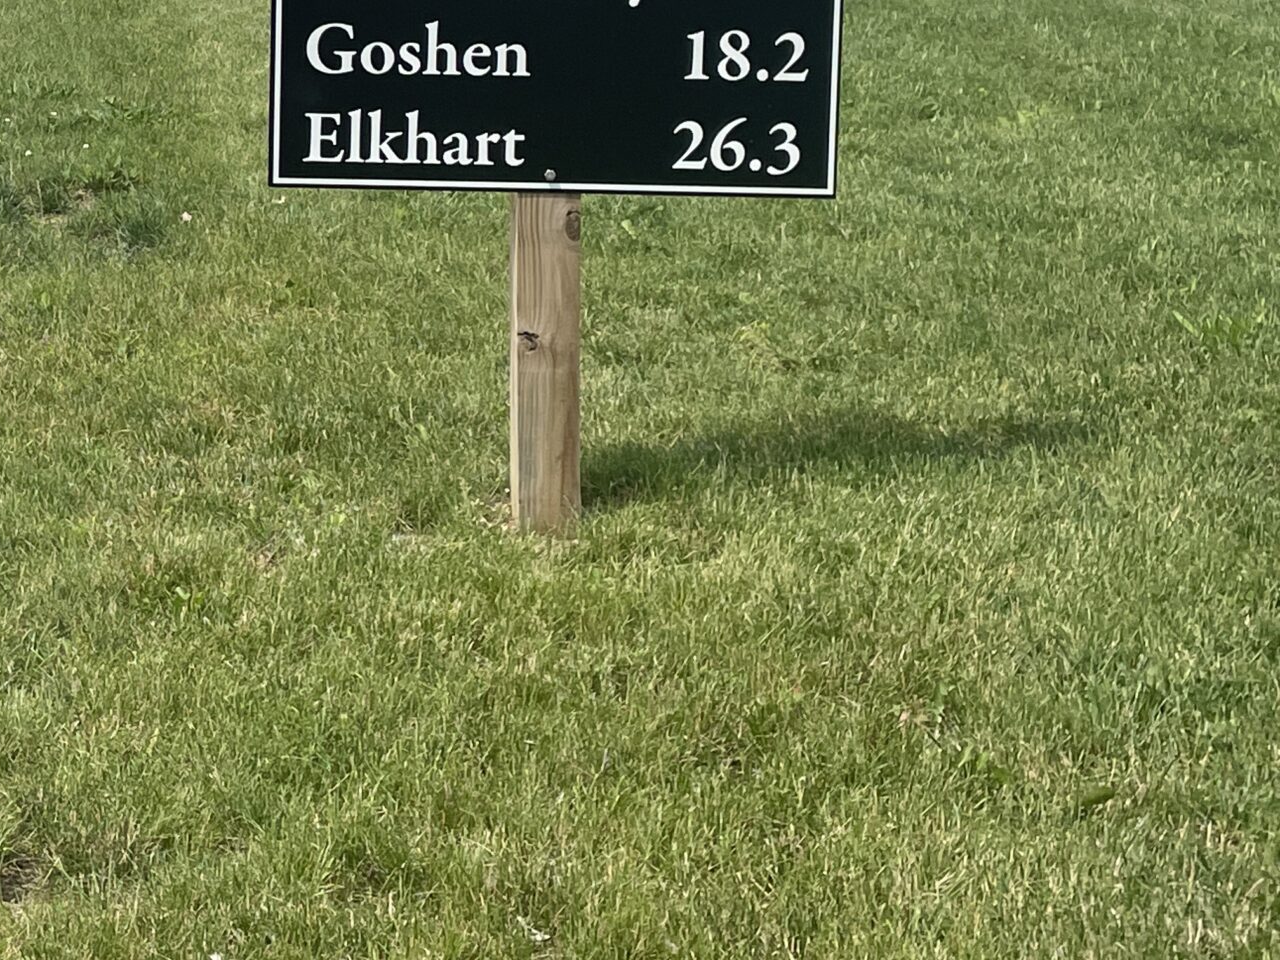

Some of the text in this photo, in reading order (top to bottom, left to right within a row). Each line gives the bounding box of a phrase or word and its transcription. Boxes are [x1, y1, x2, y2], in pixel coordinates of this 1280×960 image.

[306, 20, 809, 82] Goshen 18.2
[302, 108, 801, 176] Elkhart 26.3
